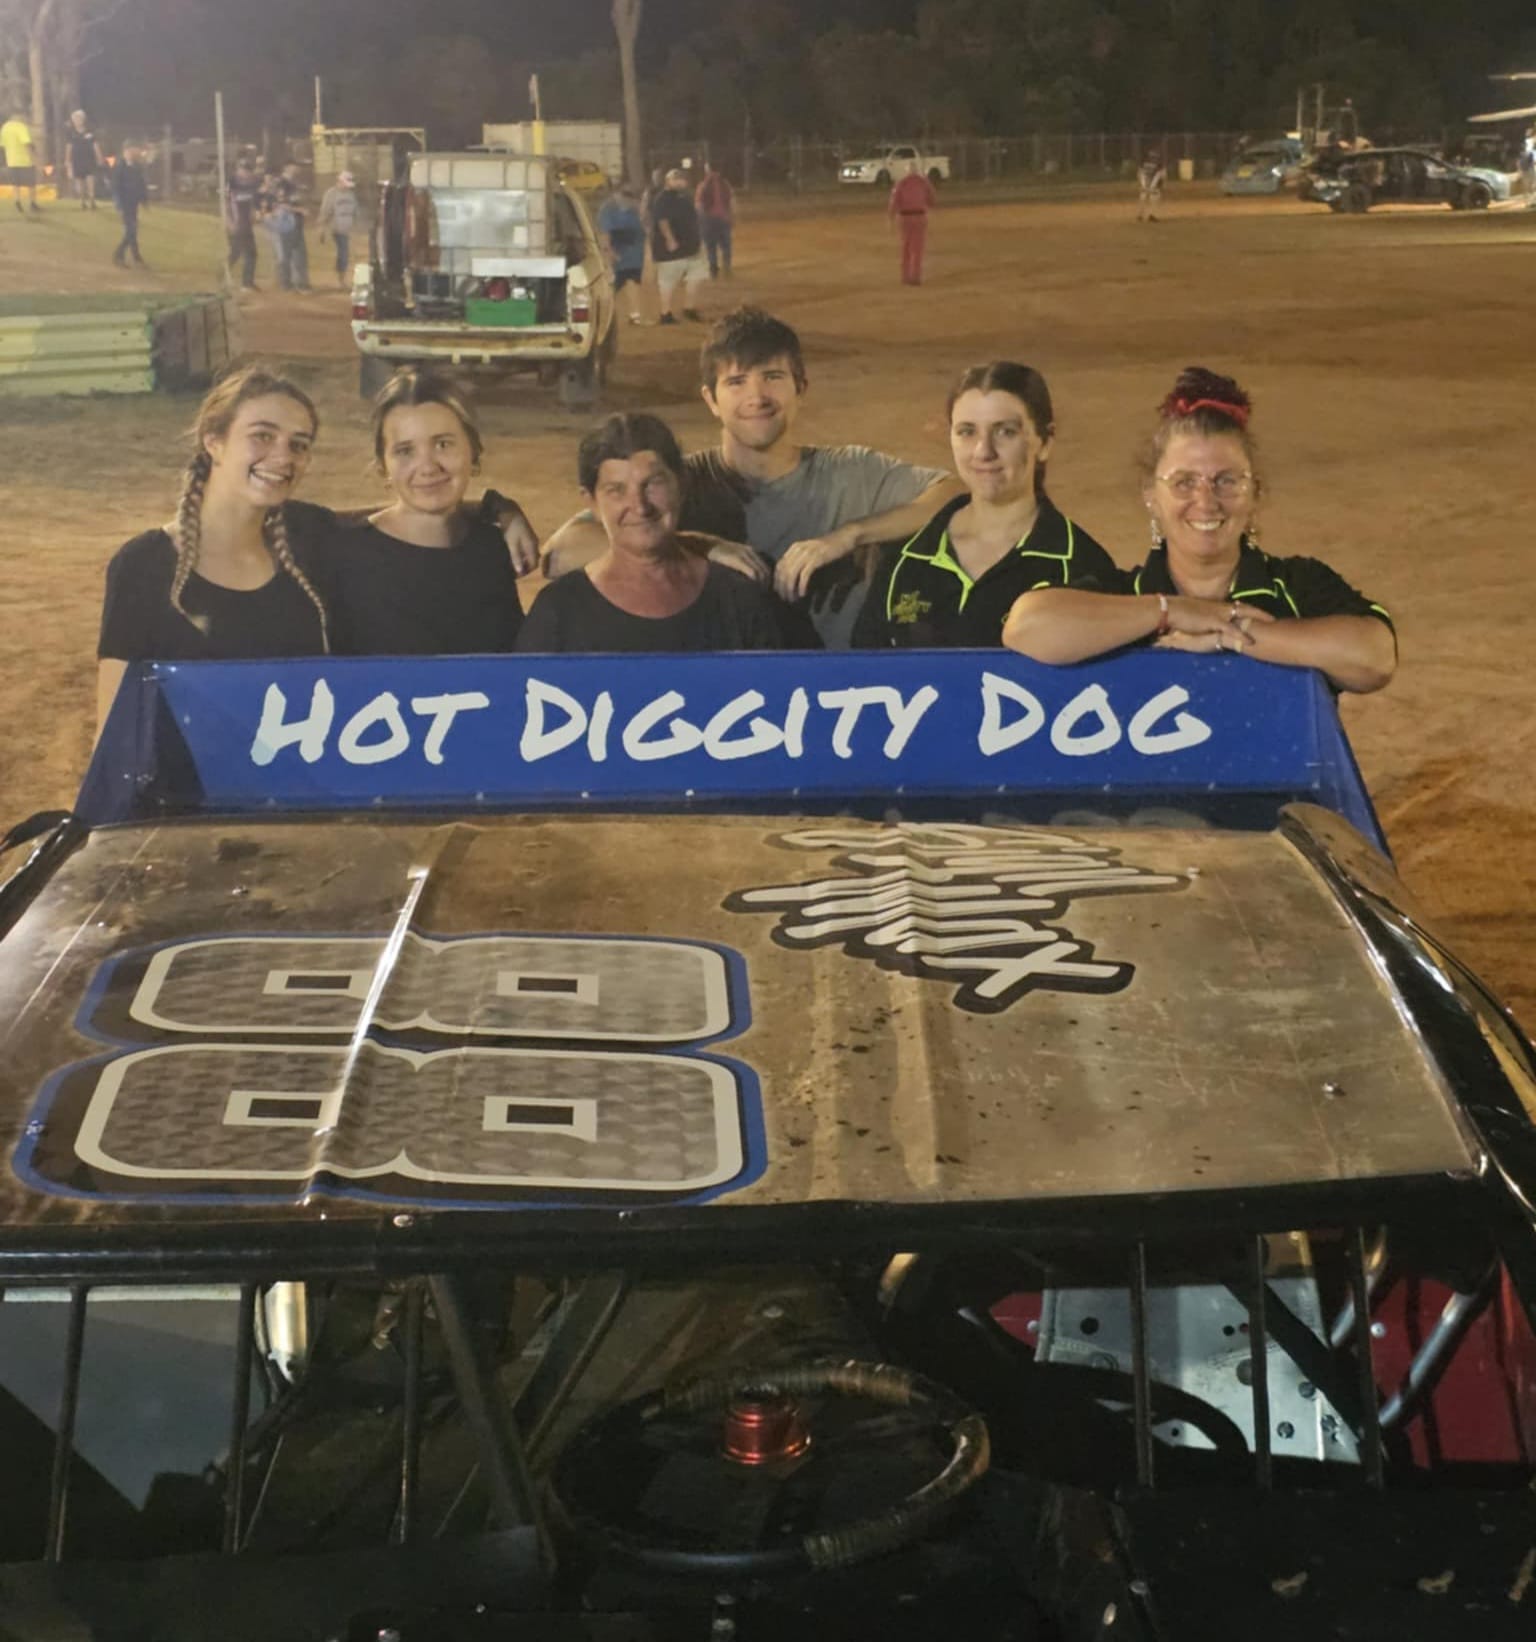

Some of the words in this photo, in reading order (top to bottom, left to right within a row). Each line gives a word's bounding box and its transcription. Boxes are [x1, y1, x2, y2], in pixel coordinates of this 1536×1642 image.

[251, 678, 490, 766] HOT
[519, 678, 939, 762] DIGGITY
[977, 671, 1212, 756] DOG
[66, 935, 750, 1195] 88
